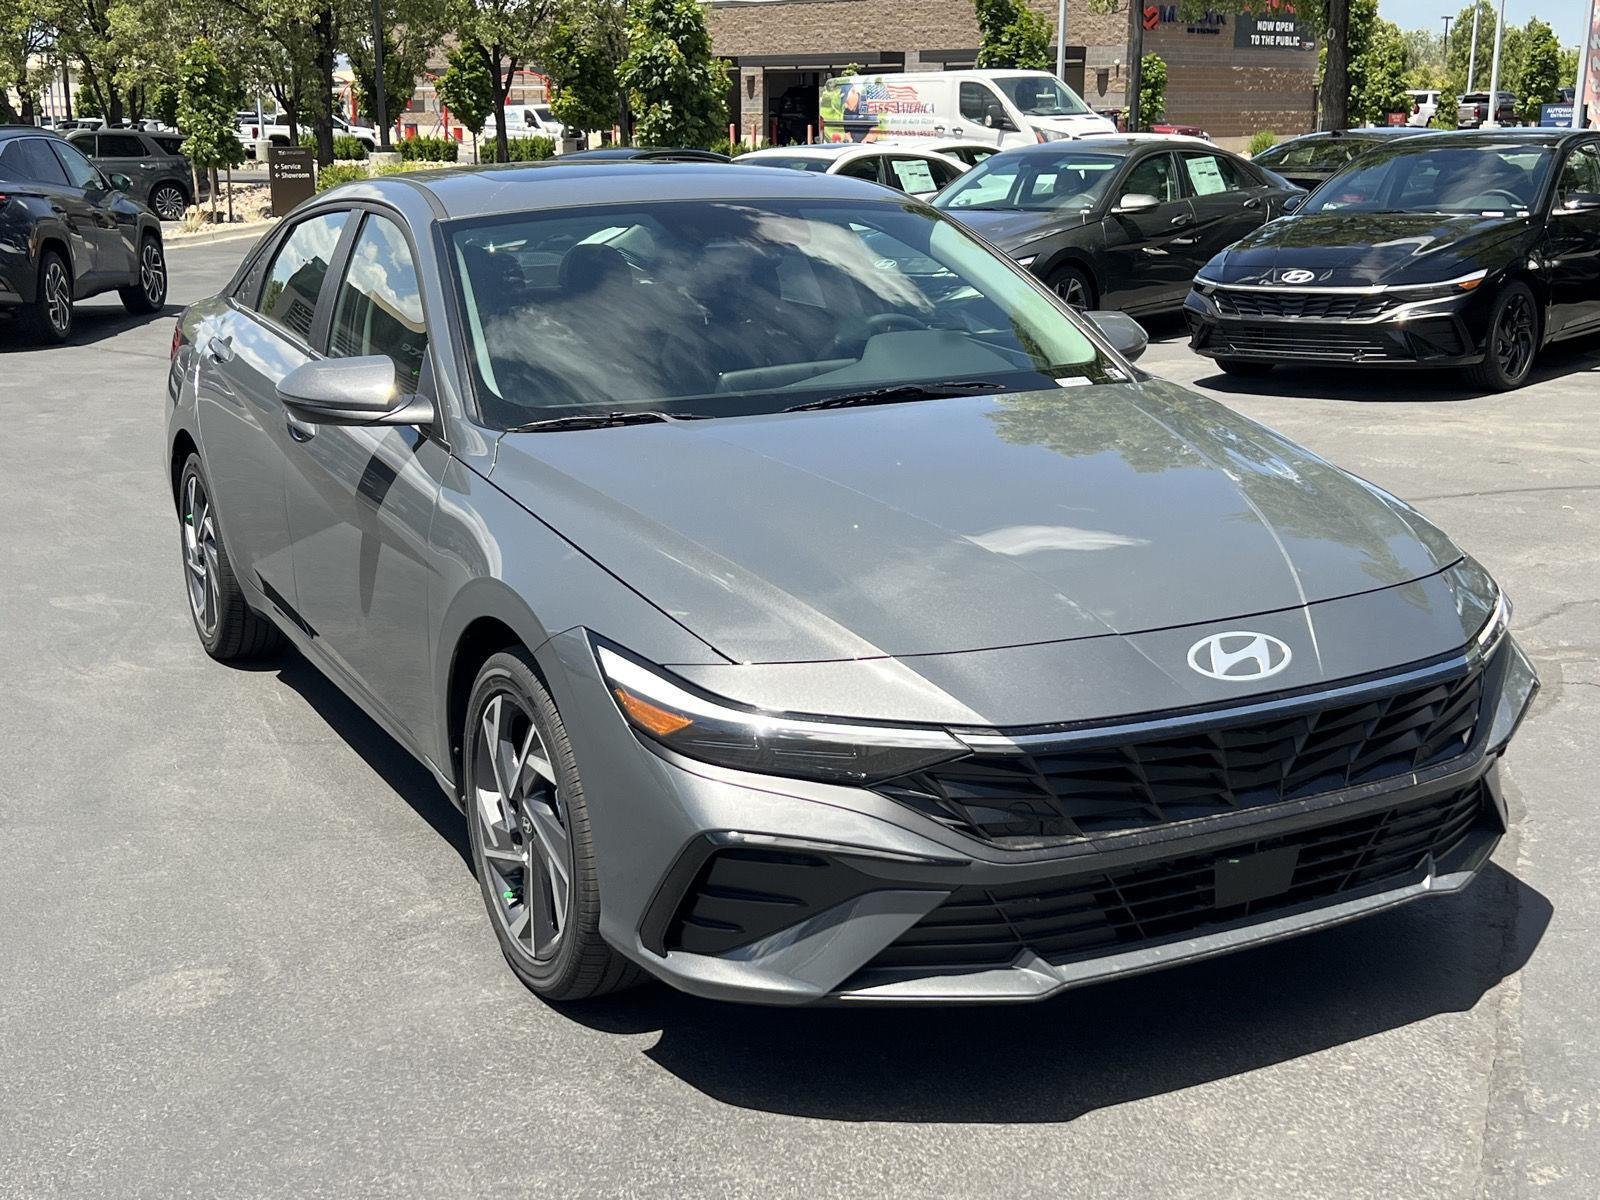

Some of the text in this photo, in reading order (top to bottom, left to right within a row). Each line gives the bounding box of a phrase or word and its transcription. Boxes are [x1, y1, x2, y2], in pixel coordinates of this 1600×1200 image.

[1257, 20, 1294, 32] NOW OPEN
[1250, 34, 1260, 45] TO
[1261, 35, 1275, 46] THE
[1275, 35, 1300, 47] PUBLIC
